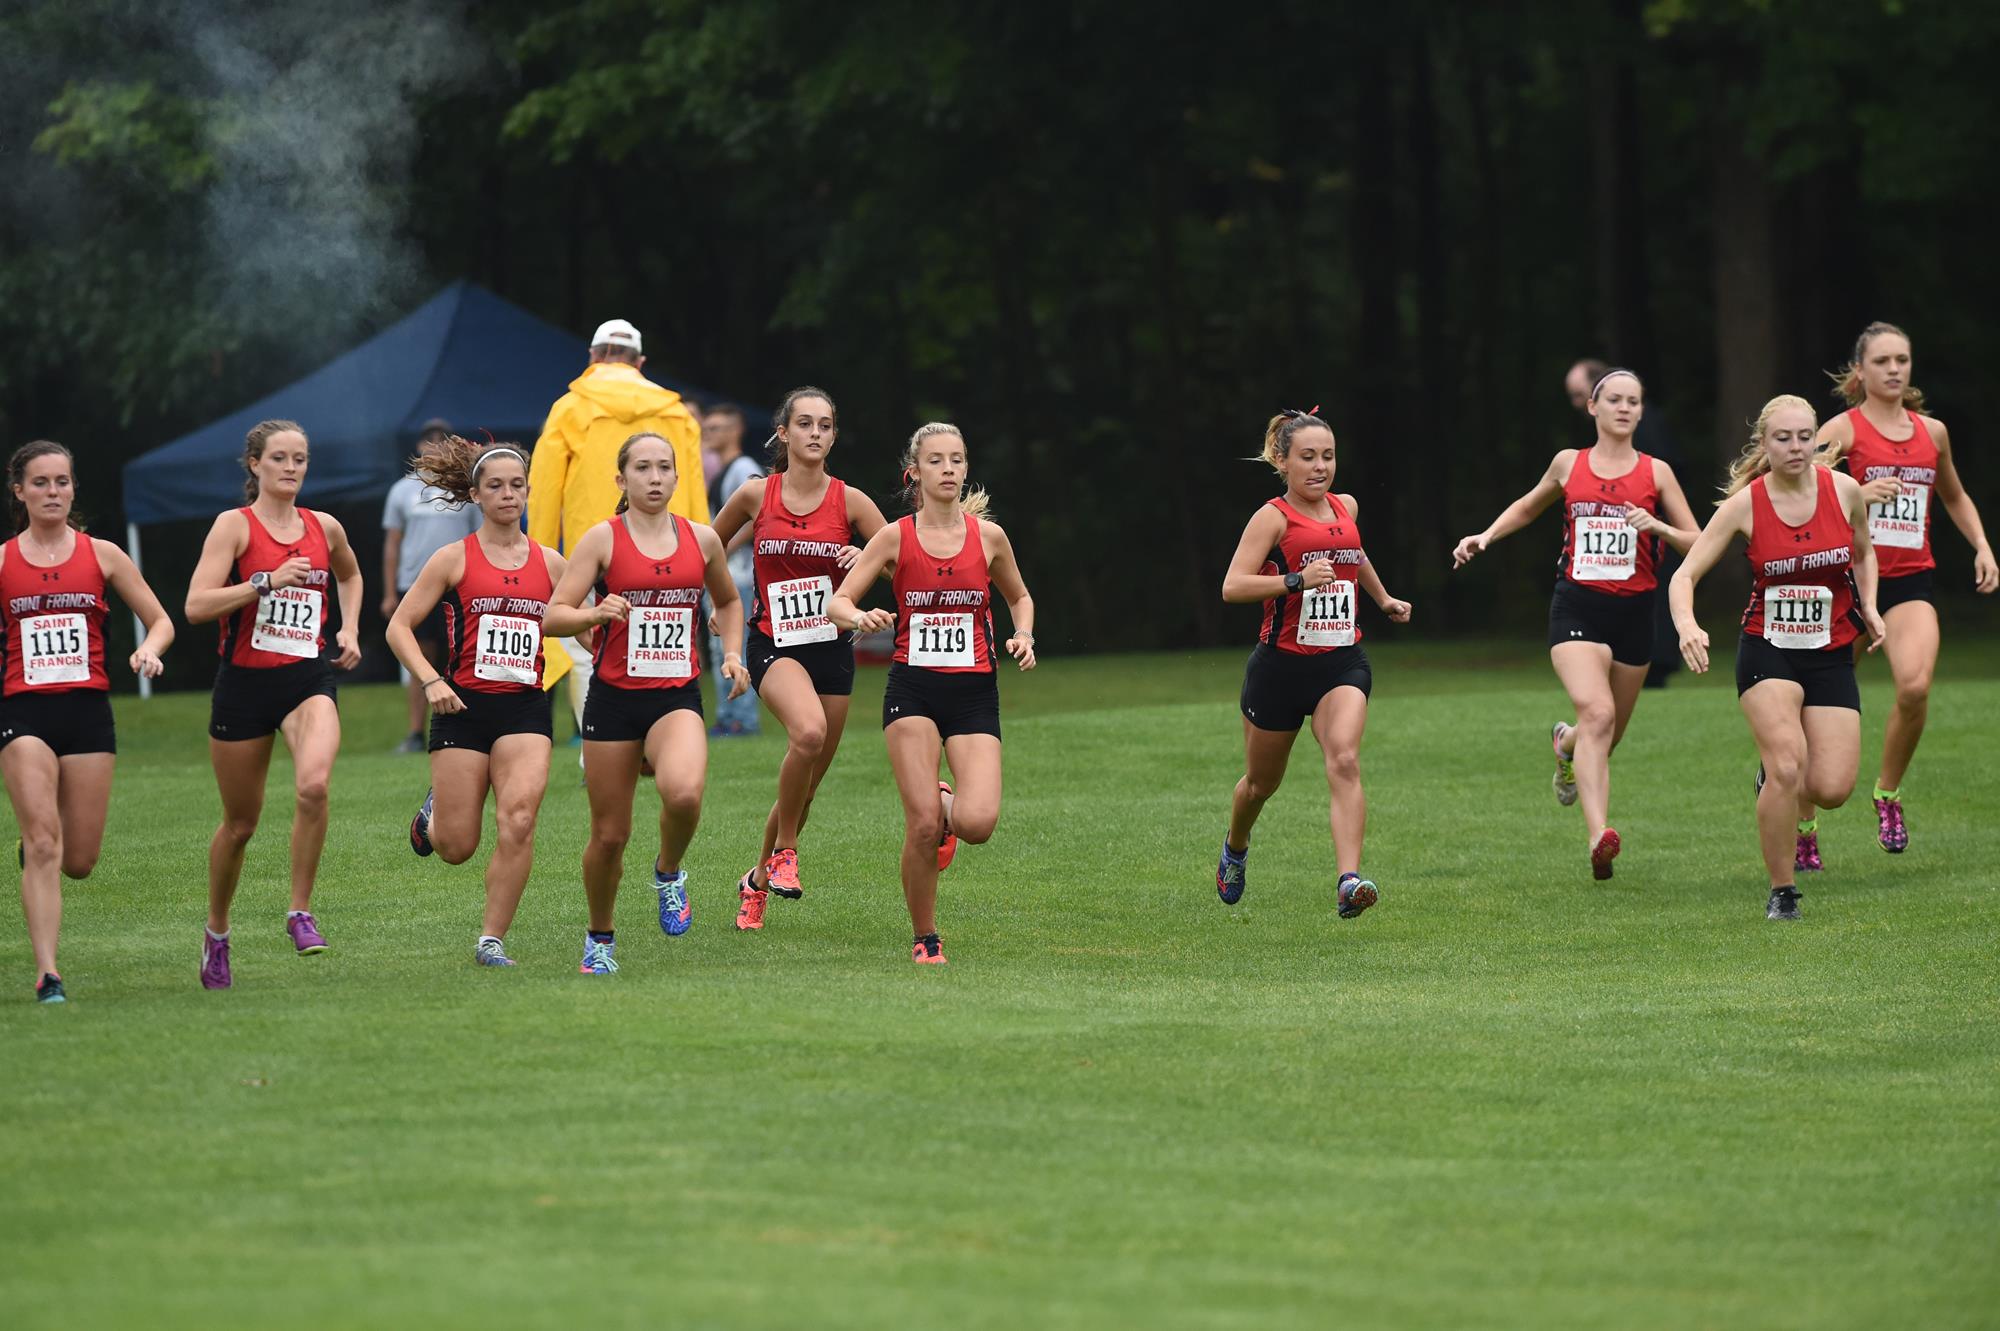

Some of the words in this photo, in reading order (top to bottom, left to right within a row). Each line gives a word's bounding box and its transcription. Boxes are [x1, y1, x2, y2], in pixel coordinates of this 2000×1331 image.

[1570, 501, 1597, 519] SAINT
[1877, 498, 1918, 522] 1121
[1587, 520, 1625, 530] SAINT
[1874, 520, 1919, 533] FRANCIS
[758, 540, 787, 555] SAINT
[791, 541, 841, 558] FRANCIS
[1583, 531, 1628, 555] 1120
[1580, 556, 1629, 567] FRANCIS
[1764, 557, 1797, 577] SAINT
[1802, 546, 1850, 570] FRANCIS
[780, 580, 819, 593] SAINT
[1778, 588, 1820, 599] SAINT
[274, 588, 311, 602] SAINT
[656, 588, 700, 604] FRANCIS
[905, 591, 935, 606] SAINT
[938, 590, 984, 605] FRANCIS
[10, 595, 42, 614] SAINT
[471, 597, 503, 613] SAINT
[778, 590, 825, 620] 1117
[1309, 595, 1350, 619] 1114
[1773, 600, 1823, 622] 1118
[265, 600, 313, 630] 1112
[643, 611, 683, 621] SAINT
[923, 616, 963, 626] SAINT
[33, 617, 74, 630] SAINT
[492, 618, 529, 631] SAINT
[779, 616, 830, 632] FRANCIS
[1304, 621, 1351, 631] FRANCIS
[1770, 623, 1824, 634] FRANCIS
[261, 625, 313, 642] FRANCIS
[638, 622, 684, 649] 1122
[918, 627, 966, 652] 1119
[30, 629, 80, 657] 1115
[486, 629, 532, 657] 1109
[30, 655, 83, 669] FRANCIS
[482, 655, 532, 669] FRANCIS
[635, 650, 686, 660] FRANCIS
